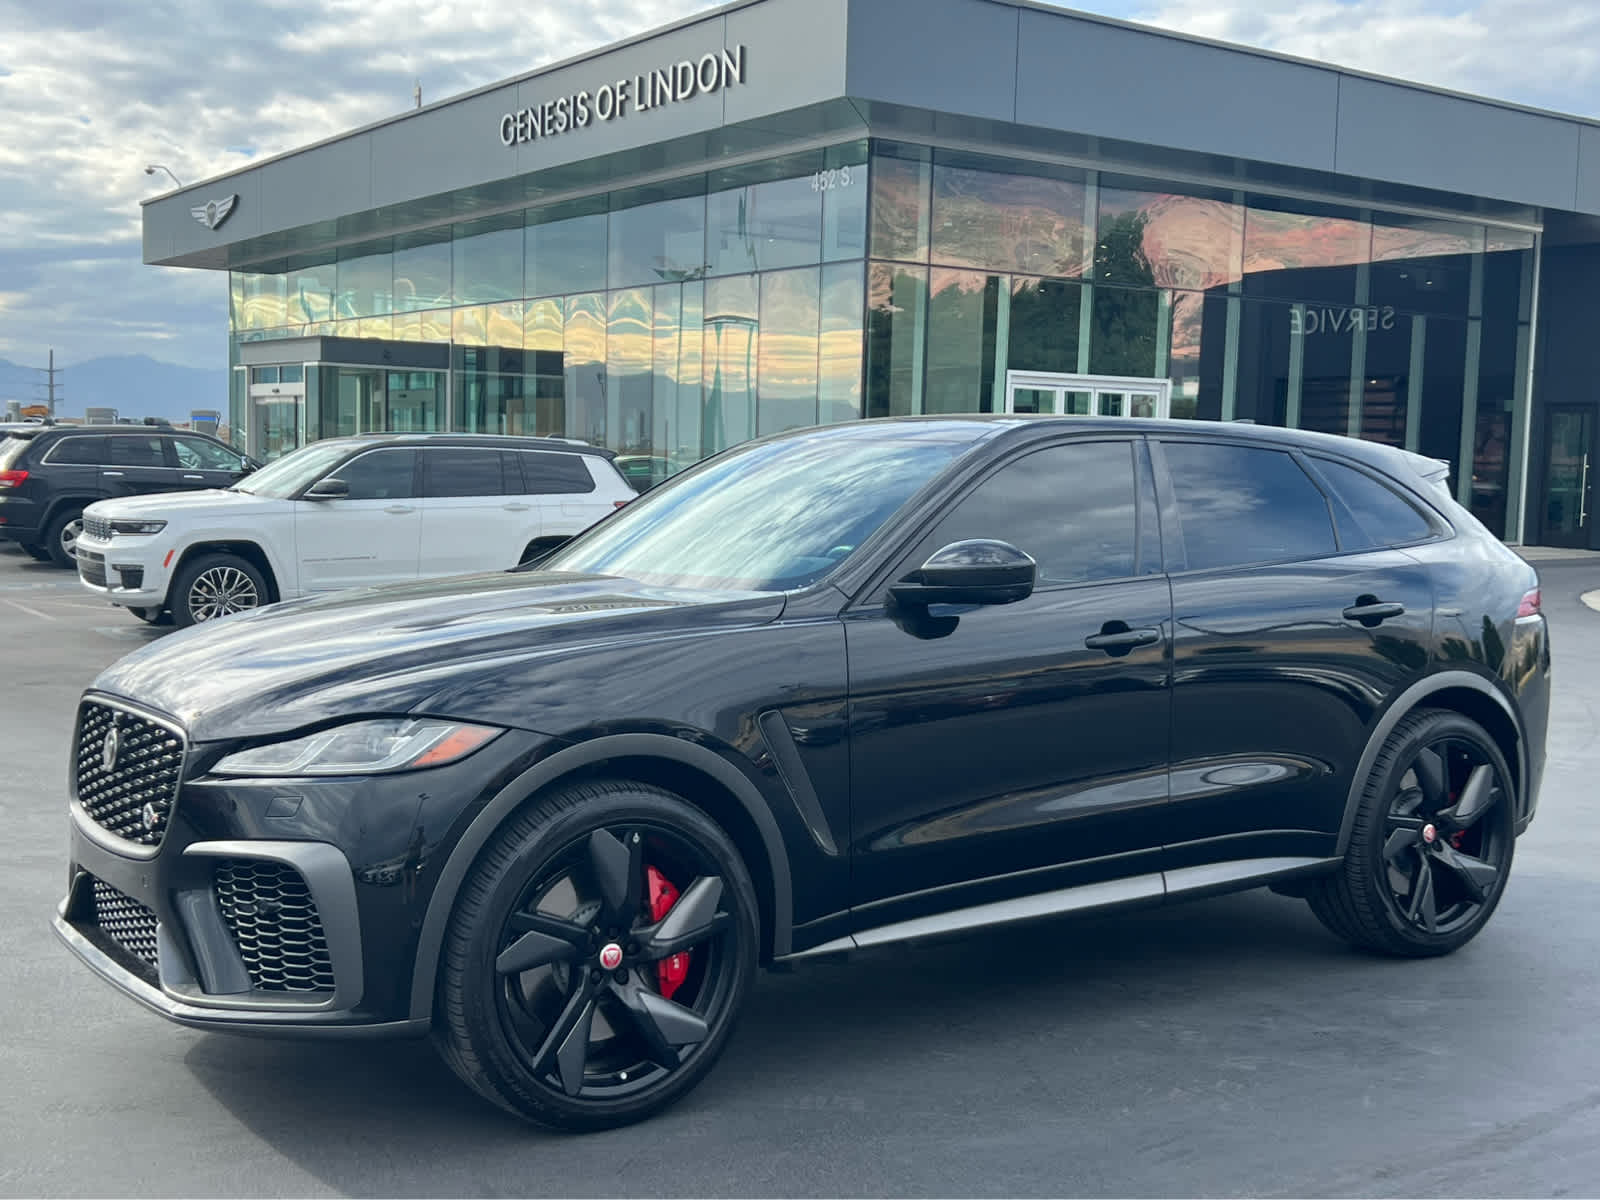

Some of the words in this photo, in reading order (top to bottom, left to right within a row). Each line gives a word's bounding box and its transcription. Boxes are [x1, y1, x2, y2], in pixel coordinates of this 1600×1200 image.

[500, 90, 590, 146] GENESIS
[596, 79, 629, 120] OF
[634, 45, 745, 111] LINDON
